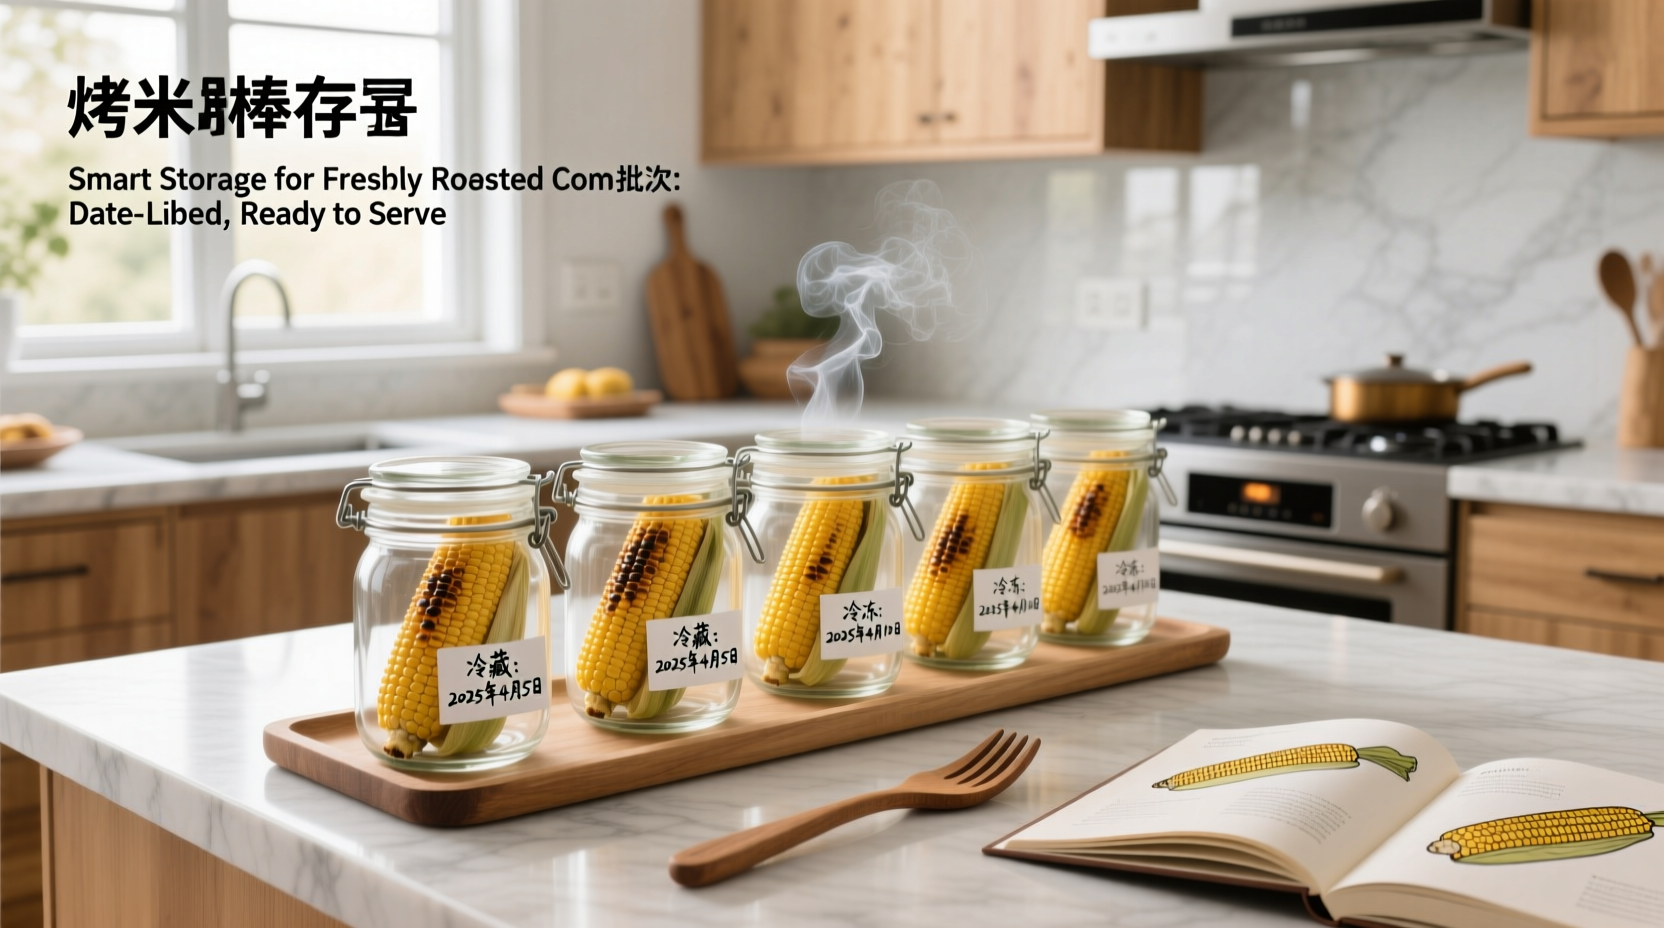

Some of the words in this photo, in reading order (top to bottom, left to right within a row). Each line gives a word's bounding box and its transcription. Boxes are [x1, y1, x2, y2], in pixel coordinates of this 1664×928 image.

[843, 600, 883, 622] 冷冻:
[673, 621, 719, 649] 冷藏:
[466, 648, 520, 679] 冷藏:
[655, 647, 739, 675] 2025年4月5日
[448, 676, 543, 707] 2025年4月5日
